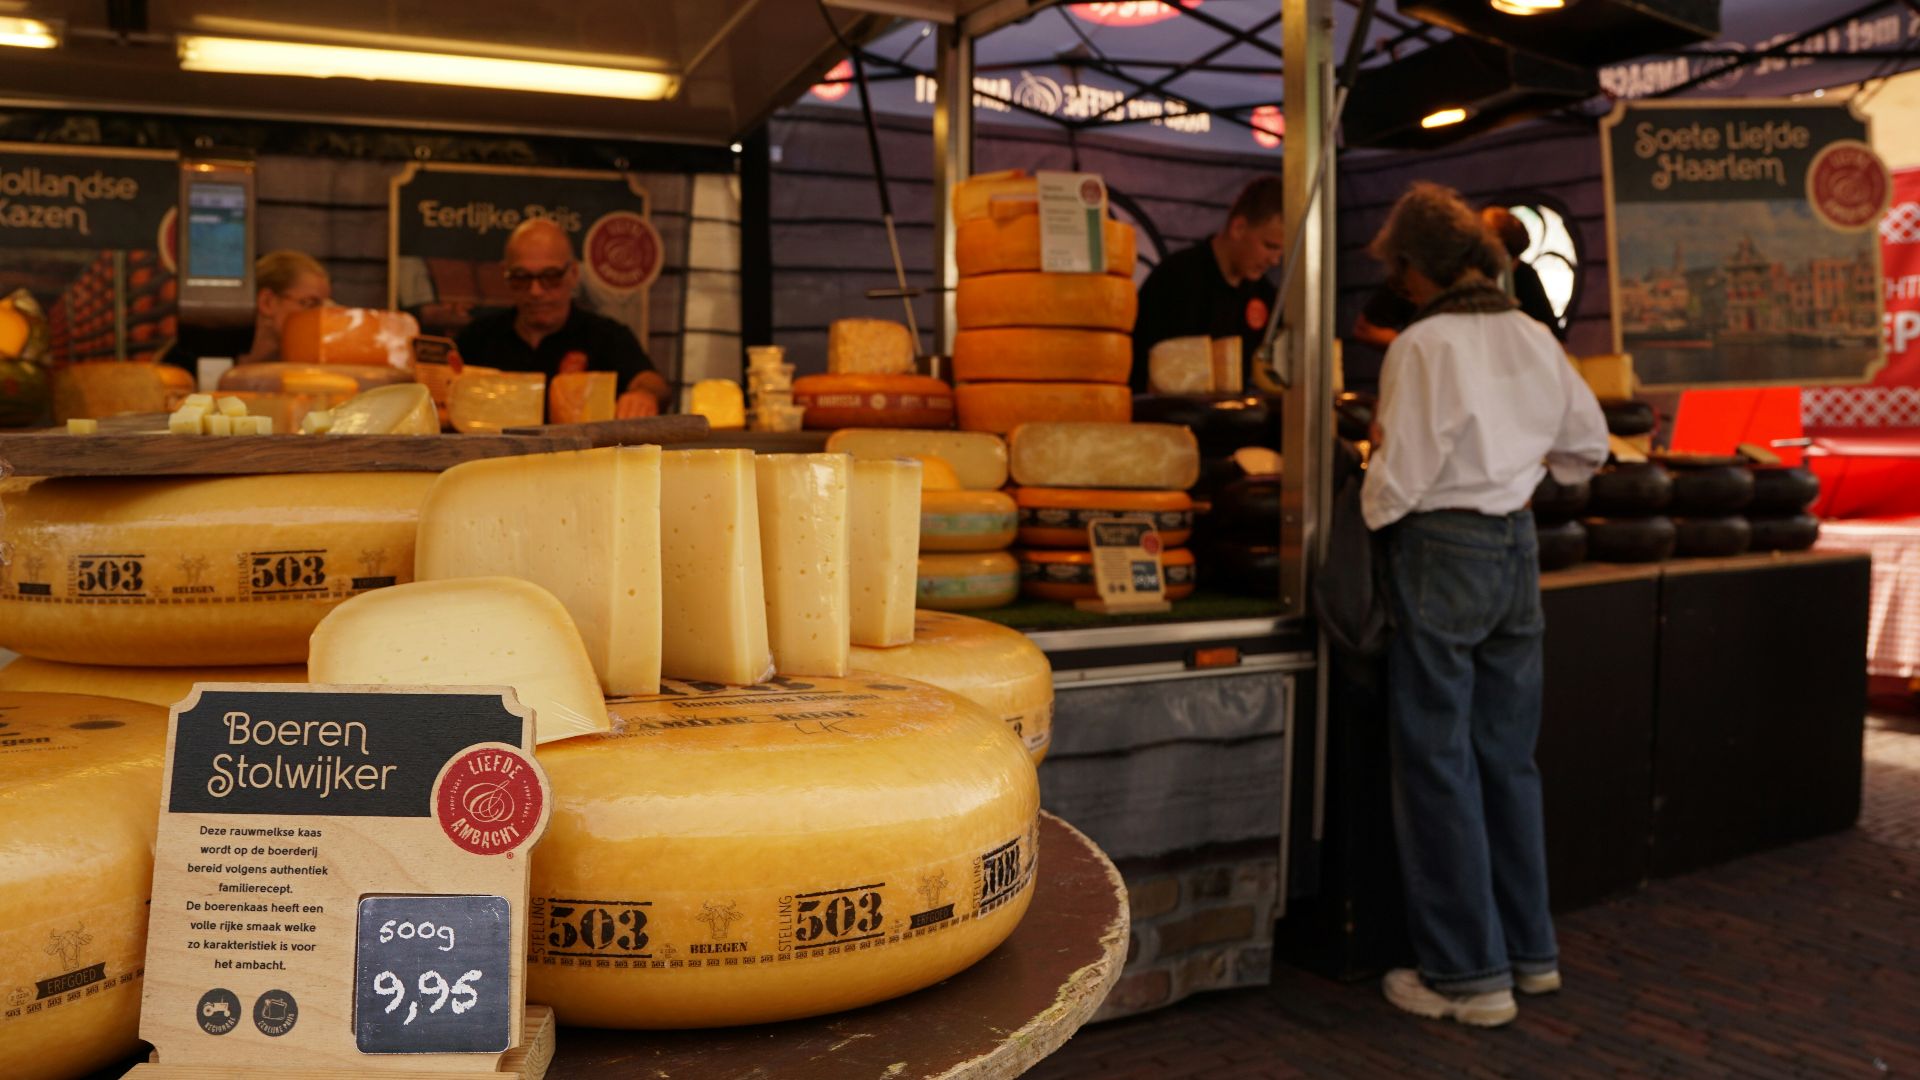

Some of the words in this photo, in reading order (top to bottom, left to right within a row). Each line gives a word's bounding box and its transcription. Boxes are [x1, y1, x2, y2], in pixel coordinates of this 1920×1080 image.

[1634, 121, 1721, 159] Soete
[1725, 120, 1811, 155] Liefde
[1, 167, 140, 205] ollandse
[1651, 153, 1787, 190] Haarlem
[418, 200, 520, 235] Eerlijke
[78, 560, 144, 592] 503
[237, 552, 249, 598] STELLING
[252, 556, 326, 588] 503
[223, 711, 370, 755] Boeren
[207, 753, 398, 798] Stolwijker
[468, 754, 523, 780] LIEFDE
[200, 825, 226, 836] Deze
[229, 826, 295, 837] rauwmelkse
[298, 827, 322, 838] kaas
[450, 817, 520, 848] AMBACHT
[200, 844, 231, 854] wordt
[234, 847, 248, 857] op
[251, 846, 264, 855] de
[267, 846, 318, 858] boerderij
[187, 863, 222, 873] bereid
[225, 864, 267, 875] volgens
[270, 865, 328, 876] authentiek
[218, 883, 293, 895] familierecept.
[186, 901, 201, 911] De
[204, 902, 268, 912] boerenkaas
[271, 903, 300, 913] heeft
[302, 904, 324, 913] een
[795, 892, 884, 942] 503
[916, 908, 950, 926] ERFGOED
[190, 921, 217, 930] volle
[219, 921, 243, 932] rijke
[246, 922, 281, 932] smaak
[284, 922, 316, 932] welke
[379, 919, 455, 951] 500g
[531, 897, 546, 955] STELLING
[548, 906, 650, 951] 503
[778, 895, 793, 952] STELLING
[187, 940, 200, 949] zo
[203, 939, 276, 951] karakteristiek
[279, 941, 288, 951] is
[291, 942, 317, 952] voor
[689, 942, 749, 955] BELEGEN
[214, 959, 232, 969] het
[235, 960, 286, 971] ambacht.
[614, 960, 628, 968] 503
[633, 960, 646, 969] 503
[651, 960, 665, 968] 503
[669, 960, 683, 968] 503
[688, 959, 702, 968] 503
[47, 969, 97, 994] ERFGOED
[373, 969, 483, 1025] 9,95
[26, 1002, 42, 1014] 503
